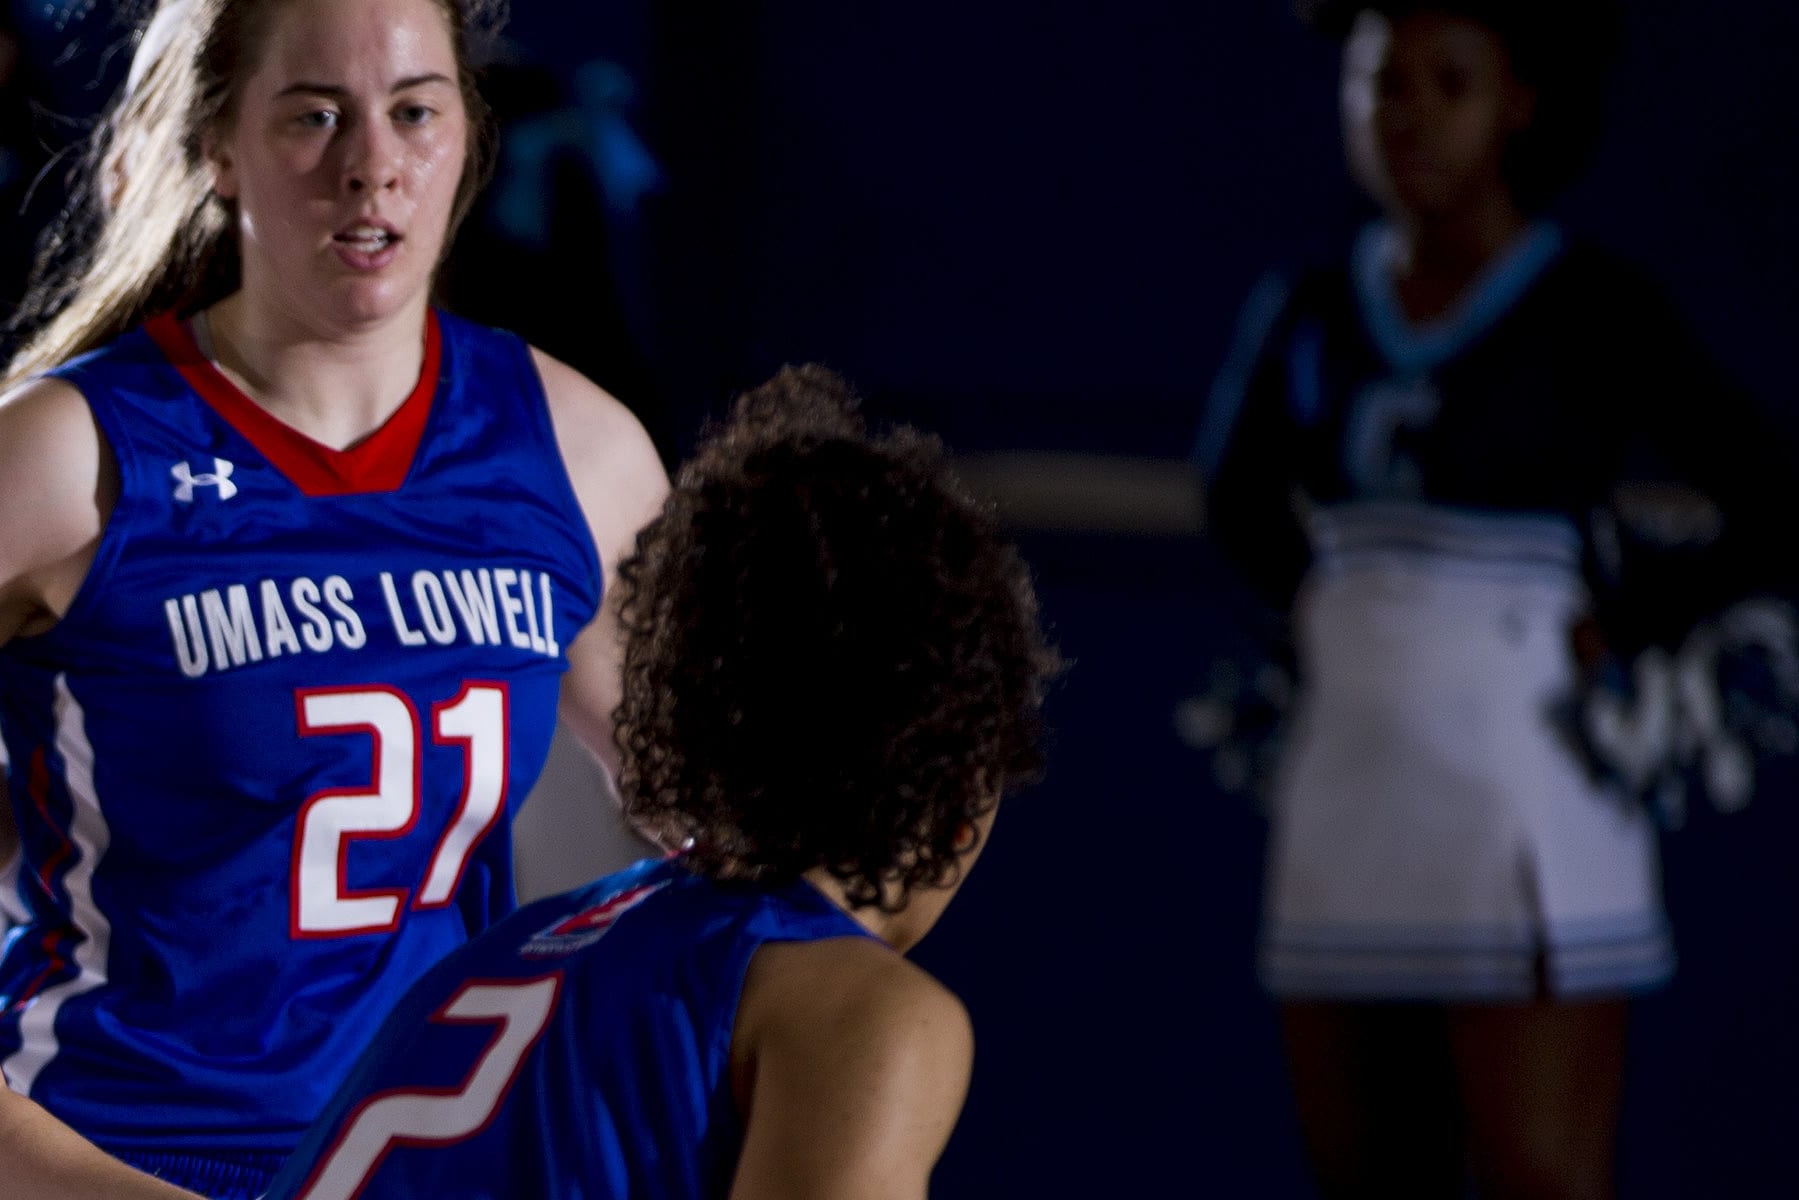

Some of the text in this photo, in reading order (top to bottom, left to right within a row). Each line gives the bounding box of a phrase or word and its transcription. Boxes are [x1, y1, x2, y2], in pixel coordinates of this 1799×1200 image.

[165, 568, 560, 678] UMASS LOWELL
[290, 679, 509, 940] 21
